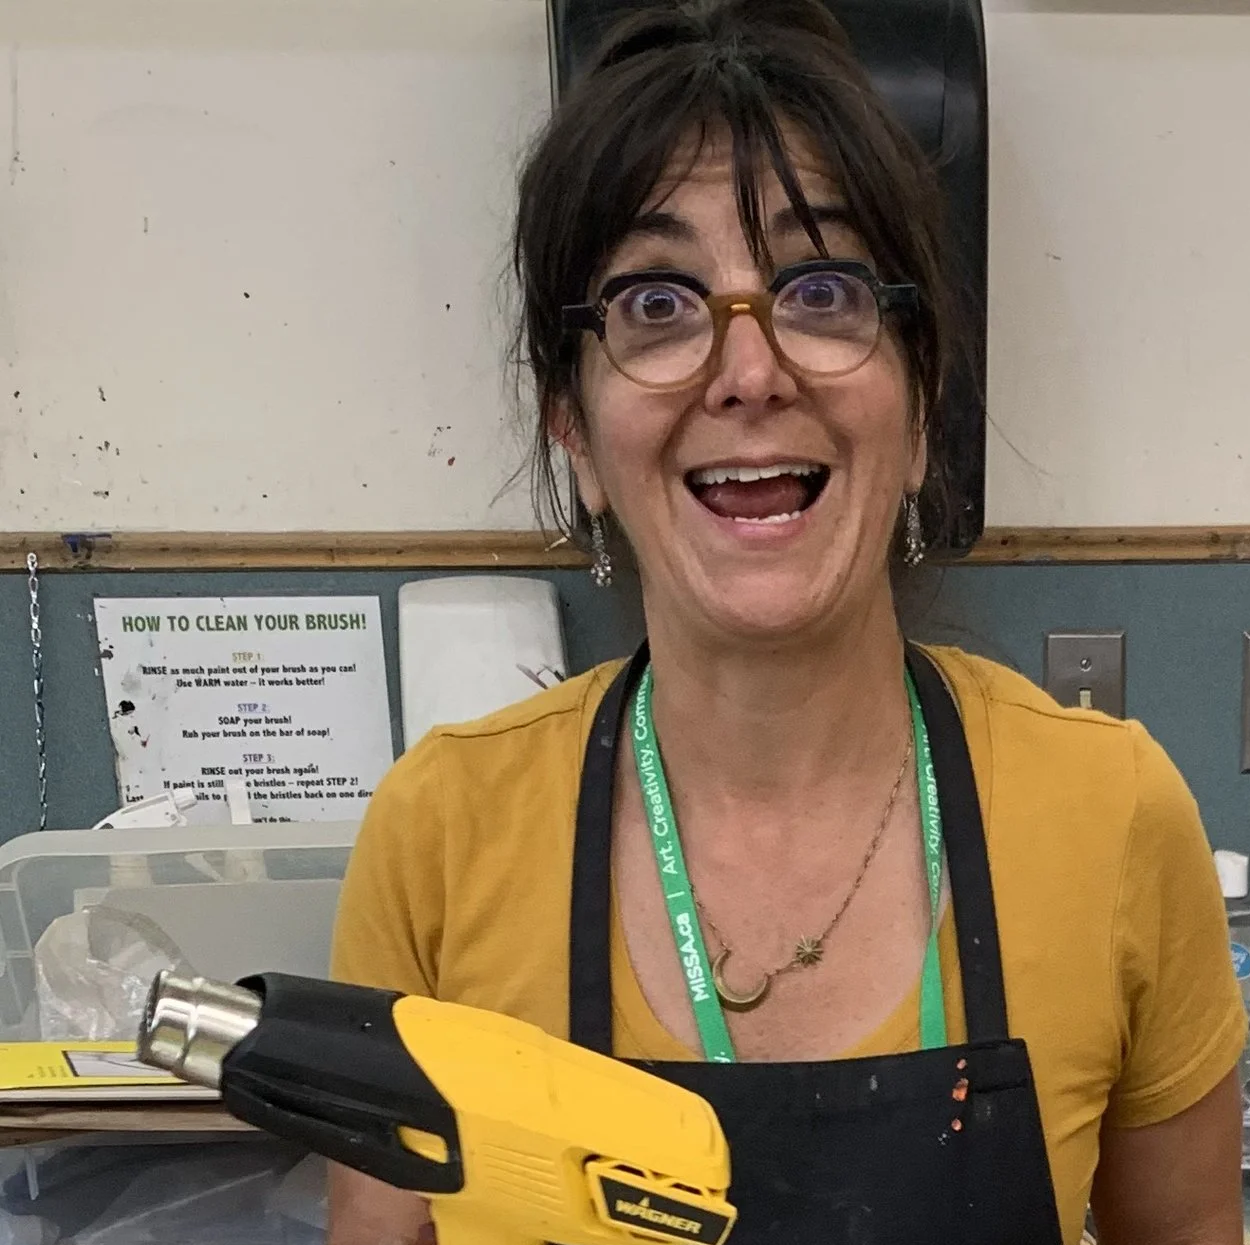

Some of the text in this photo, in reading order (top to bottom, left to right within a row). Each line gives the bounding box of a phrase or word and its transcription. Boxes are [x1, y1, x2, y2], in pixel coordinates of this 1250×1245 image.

[122, 613, 366, 631] HOW TO CLEAN YOUR BRUSH!
[143, 665, 167, 674] RINSE
[182, 666, 204, 674] much
[207, 666, 229, 675] paint
[260, 667, 279, 675] your
[282, 664, 306, 672] brush
[321, 666, 336, 674] you
[176, 679, 192, 687] Use
[194, 678, 220, 686] WARM
[295, 677, 324, 685] better!
[237, 703, 258, 712] STEP
[218, 716, 240, 724] SOAP
[243, 718, 262, 726] your
[201, 731, 220, 739] your
[222, 729, 246, 737] brush
[279, 728, 292, 736] bar
[306, 728, 329, 737] soap!
[242, 754, 263, 762] STEP
[201, 767, 225, 775] RINSE
[245, 768, 263, 776] your
[266, 766, 290, 774] brush
[293, 766, 318, 776] again!
[172, 780, 194, 789] paint
[253, 778, 286, 786] bristles
[296, 779, 324, 787] repeat
[326, 777, 346, 785] STEP
[253, 791, 267, 799] the
[304, 790, 323, 798] back
[640, 744, 670, 838] Creativity.
[661, 840, 678, 875] Art.
[675, 912, 710, 1002] MISSA.ca
[615, 1198, 702, 1234] WAGNER
